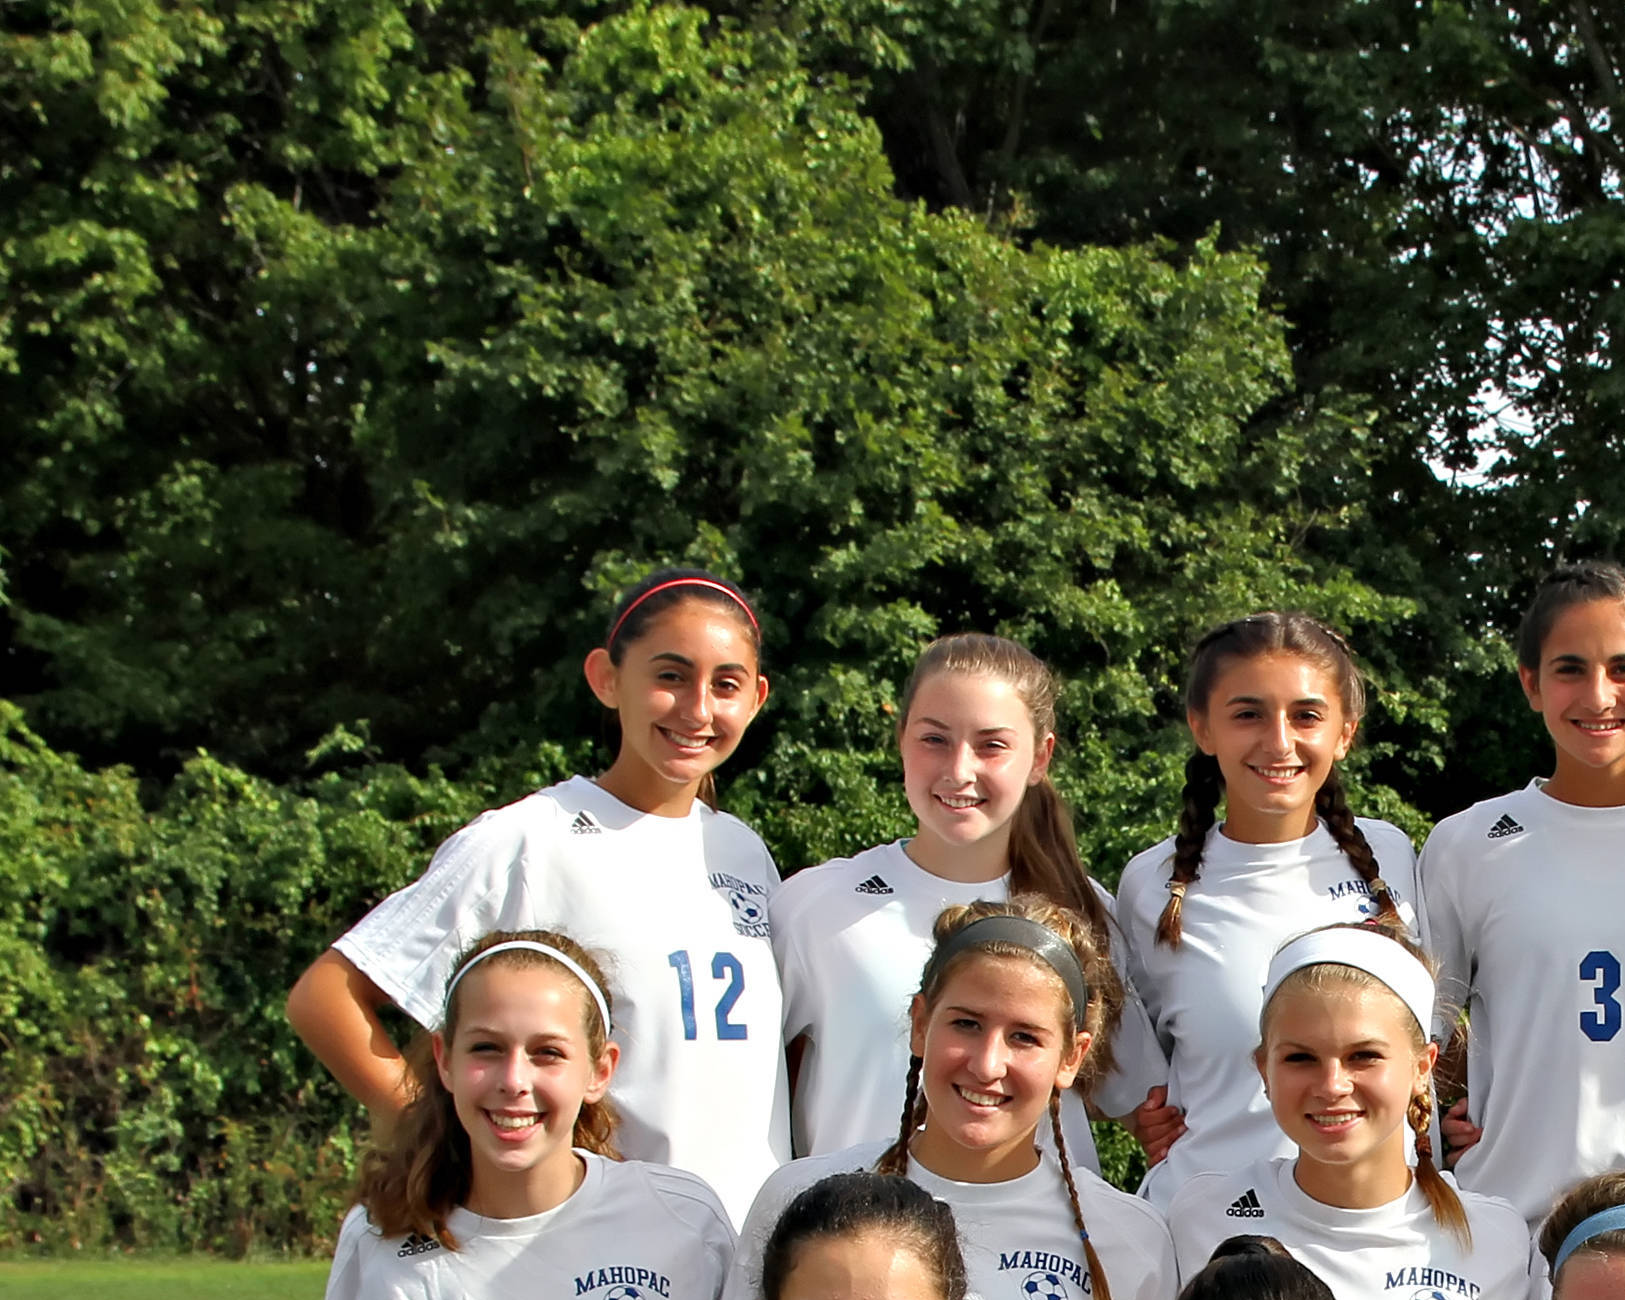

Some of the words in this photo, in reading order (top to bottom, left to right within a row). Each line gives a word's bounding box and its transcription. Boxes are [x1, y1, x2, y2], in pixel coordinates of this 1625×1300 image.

[855, 886, 894, 895] adidas
[668, 950, 748, 1041] 12
[1579, 951, 1622, 1042] 3
[1226, 1206, 1265, 1218] adidas
[575, 1266, 670, 1298] MAHOPAC
[998, 1251, 1092, 1295] MAHOPAC
